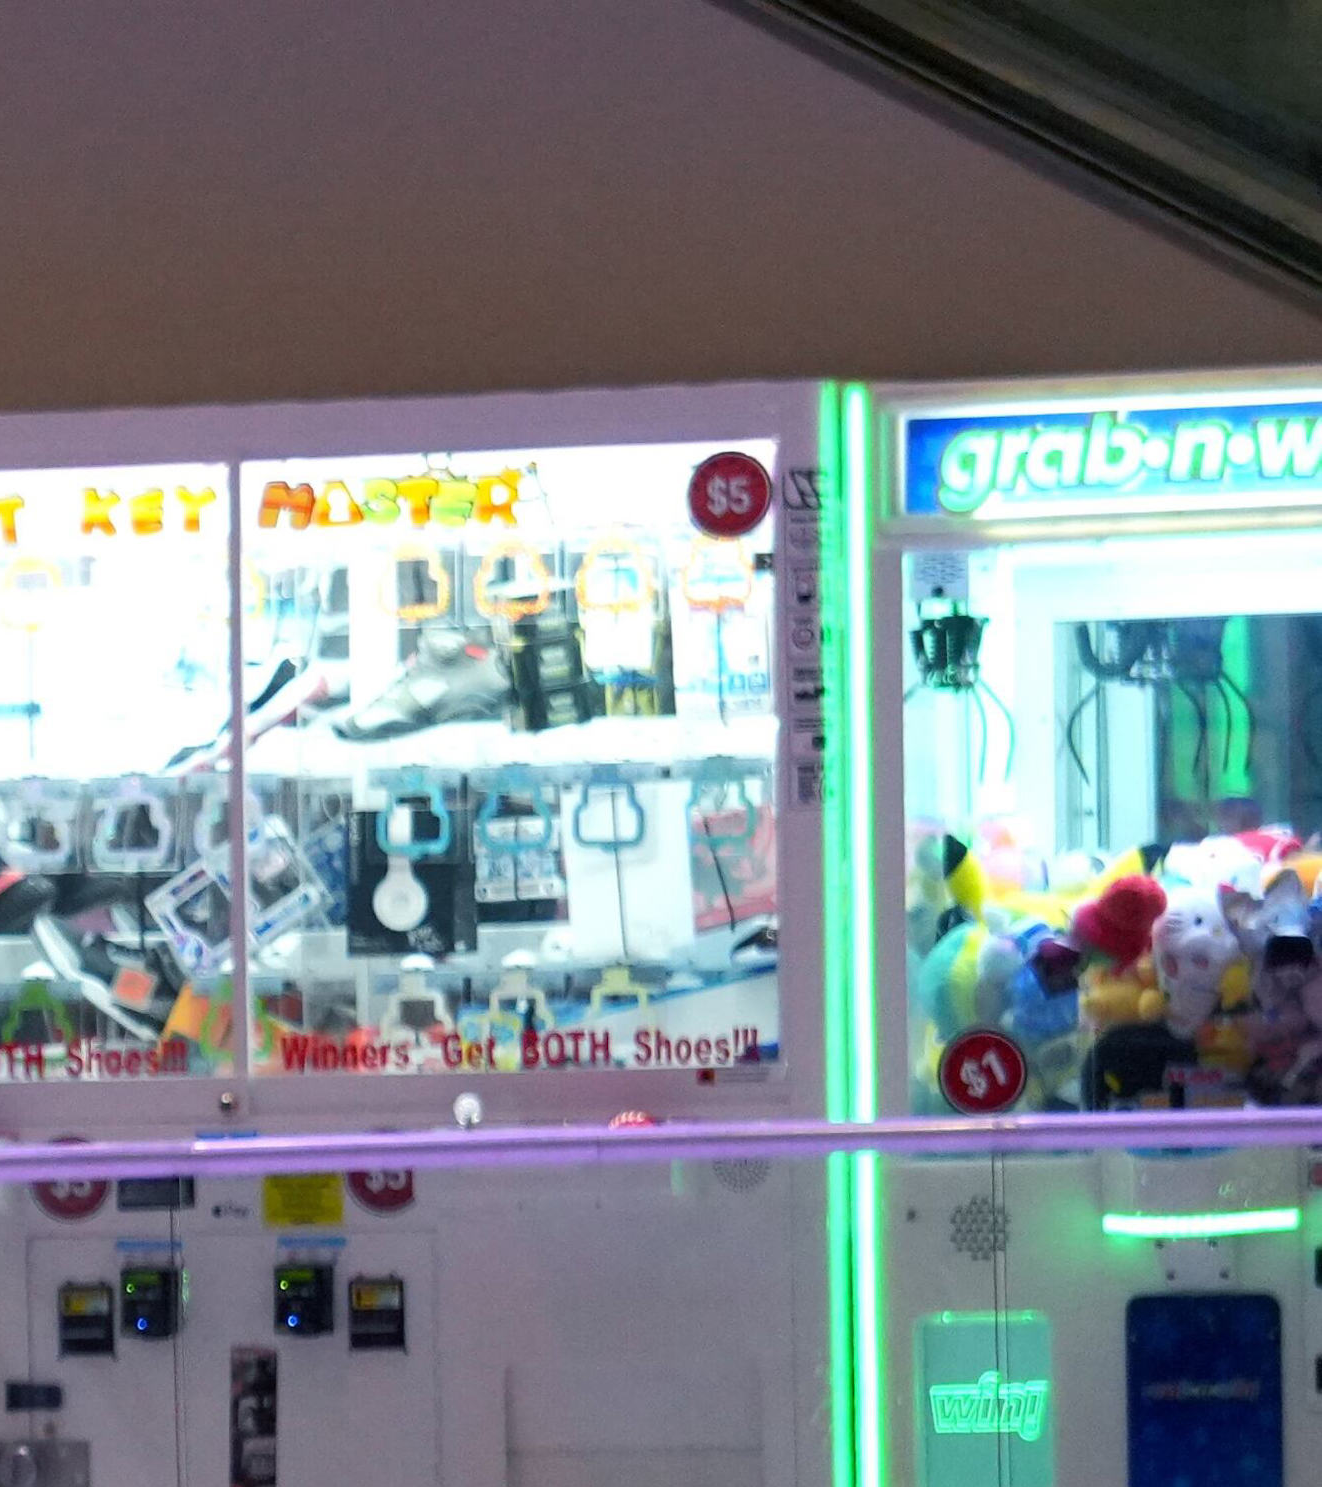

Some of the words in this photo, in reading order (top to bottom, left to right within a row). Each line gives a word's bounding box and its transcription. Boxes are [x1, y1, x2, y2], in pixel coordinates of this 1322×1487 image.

[81, 486, 216, 535] KEY
[258, 476, 519, 530] MASTER
[706, 475, 751, 518] $5
[280, 1035, 410, 1072] Winners
[442, 1034, 497, 1070] Get
[522, 1029, 612, 1069] BOTH
[633, 1026, 760, 1067] Shoes!!!
[959, 1048, 1007, 1099] $1
